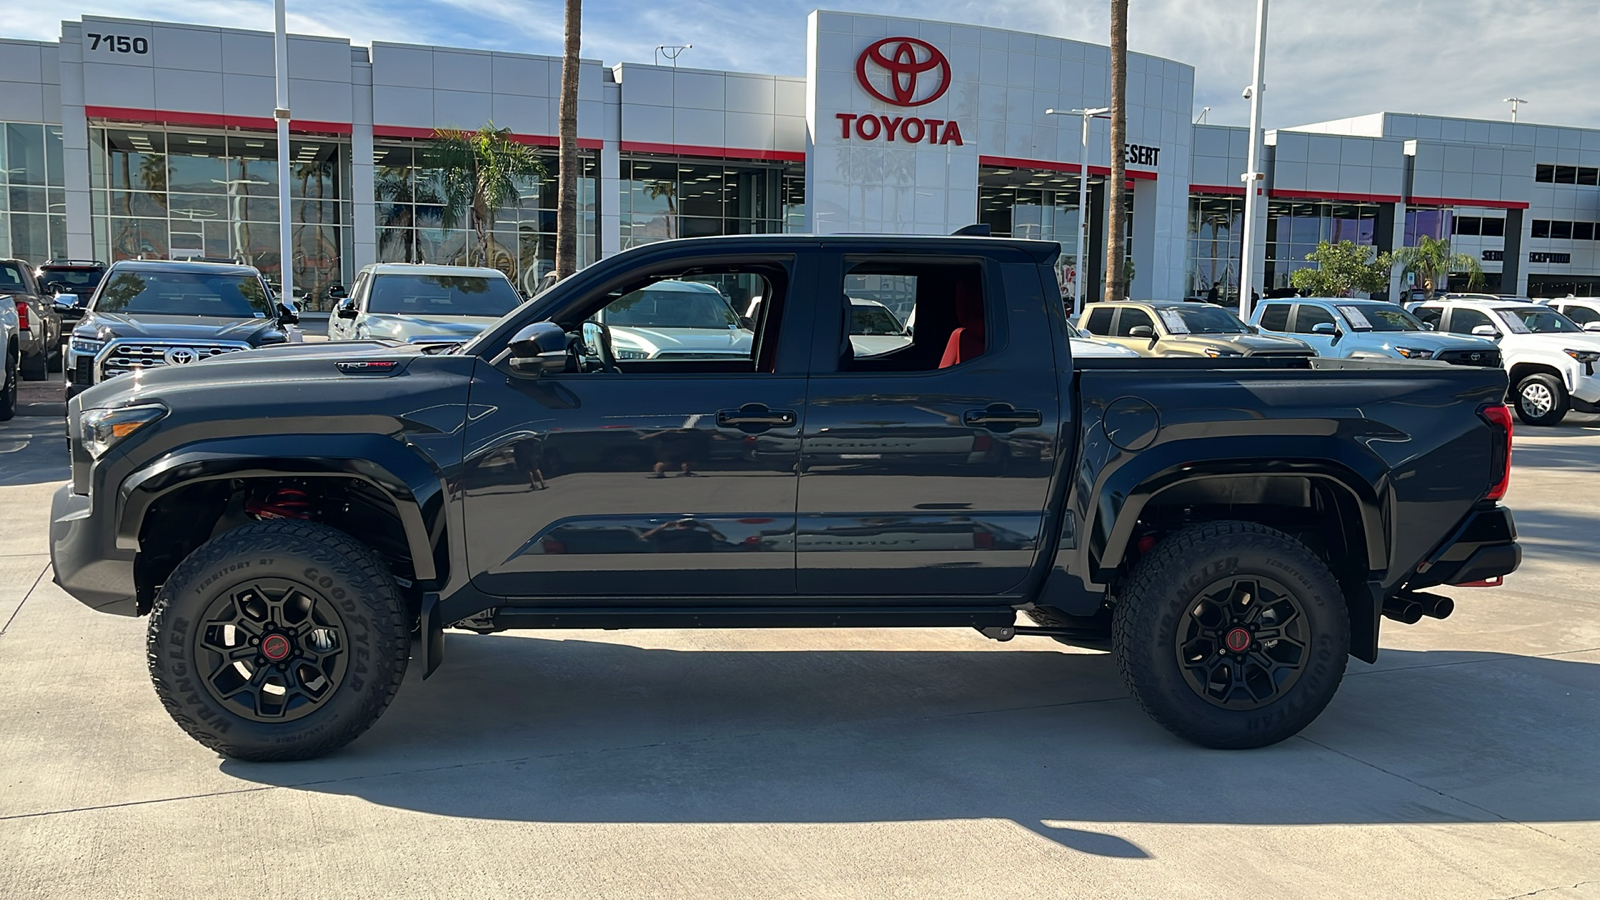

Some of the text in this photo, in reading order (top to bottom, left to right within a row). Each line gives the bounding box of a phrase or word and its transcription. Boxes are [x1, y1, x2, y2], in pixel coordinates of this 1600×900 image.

[87, 33, 148, 54] 7150
[836, 113, 963, 146] TOYOTA
[1125, 143, 1160, 167] ESERT
[195, 560, 251, 595] TERRITORY
[1158, 557, 1239, 647] WRANGLER
[303, 567, 371, 692] GOODYEAR
[169, 617, 233, 733] WRANGLER
